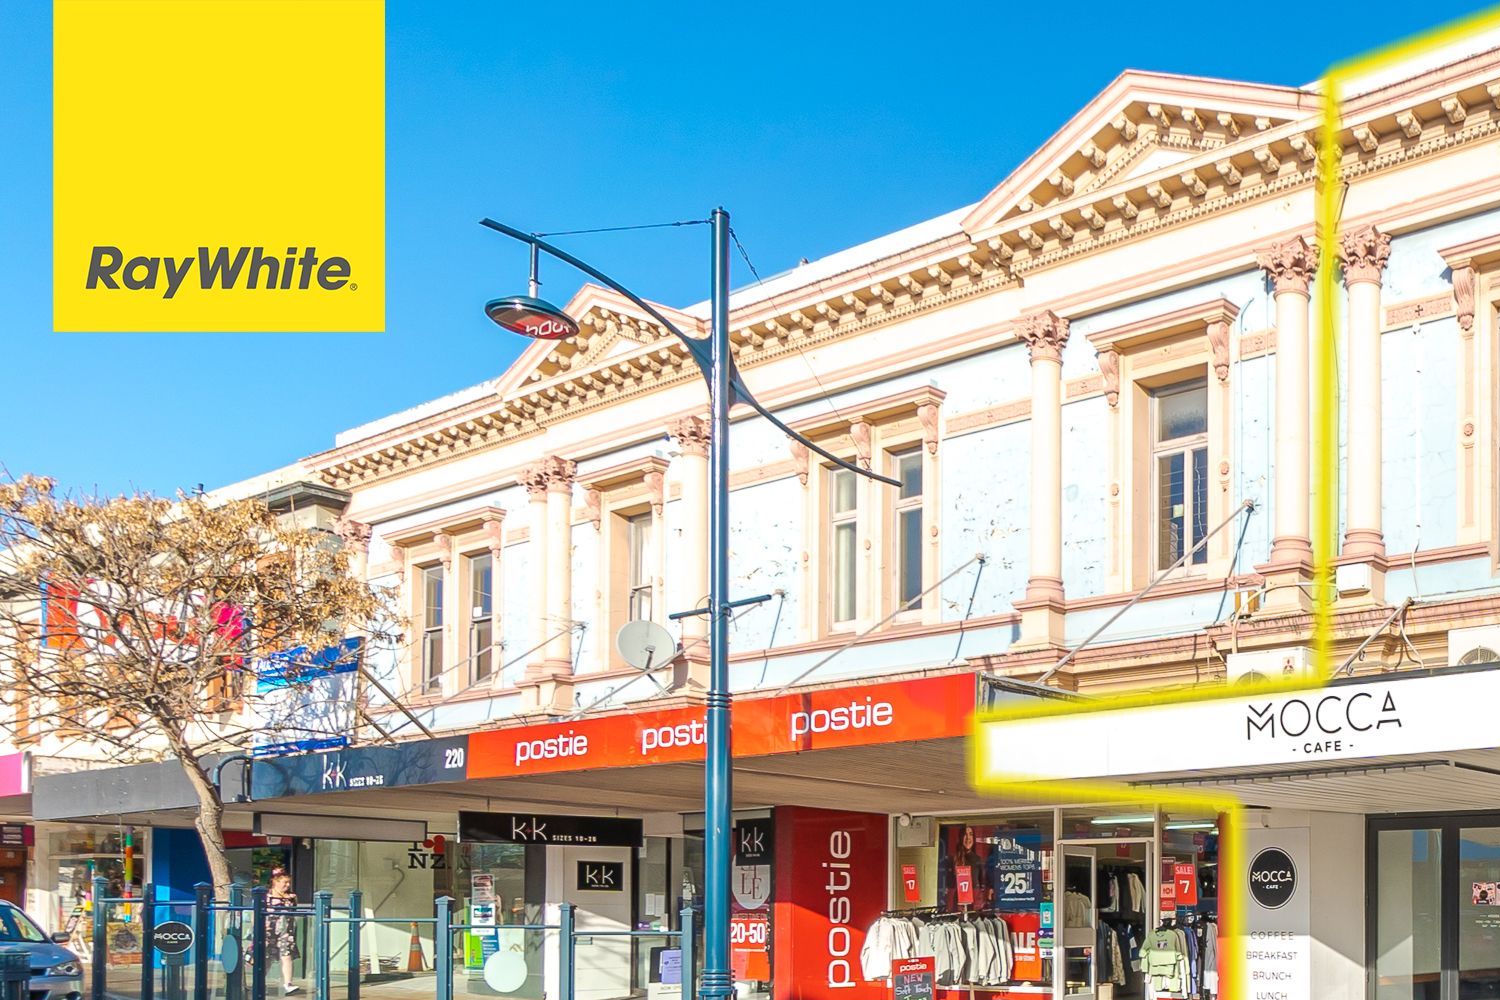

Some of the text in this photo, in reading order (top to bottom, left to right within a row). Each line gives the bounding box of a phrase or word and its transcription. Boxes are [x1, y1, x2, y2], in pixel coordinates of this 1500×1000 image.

[791, 697, 893, 741] postie
[1247, 690, 1402, 740] MOCCA
[641, 718, 708, 754] posti
[515, 730, 588, 766] postie
[1303, 740, 1342, 753] CAFE
[445, 748, 464, 769] 220
[1000, 872, 1027, 894] $25
[1252, 870, 1293, 882] MOCCA
[822, 830, 856, 989] postie
[1011, 932, 1036, 953] ALE
[1250, 931, 1295, 940] COFFEE
[1246, 951, 1298, 960] BREAKFAST
[900, 963, 927, 974] postie
[1252, 971, 1291, 980] BRUNCH
[904, 974, 923, 985] NEW
[1256, 991, 1288, 1000] LUNCH
